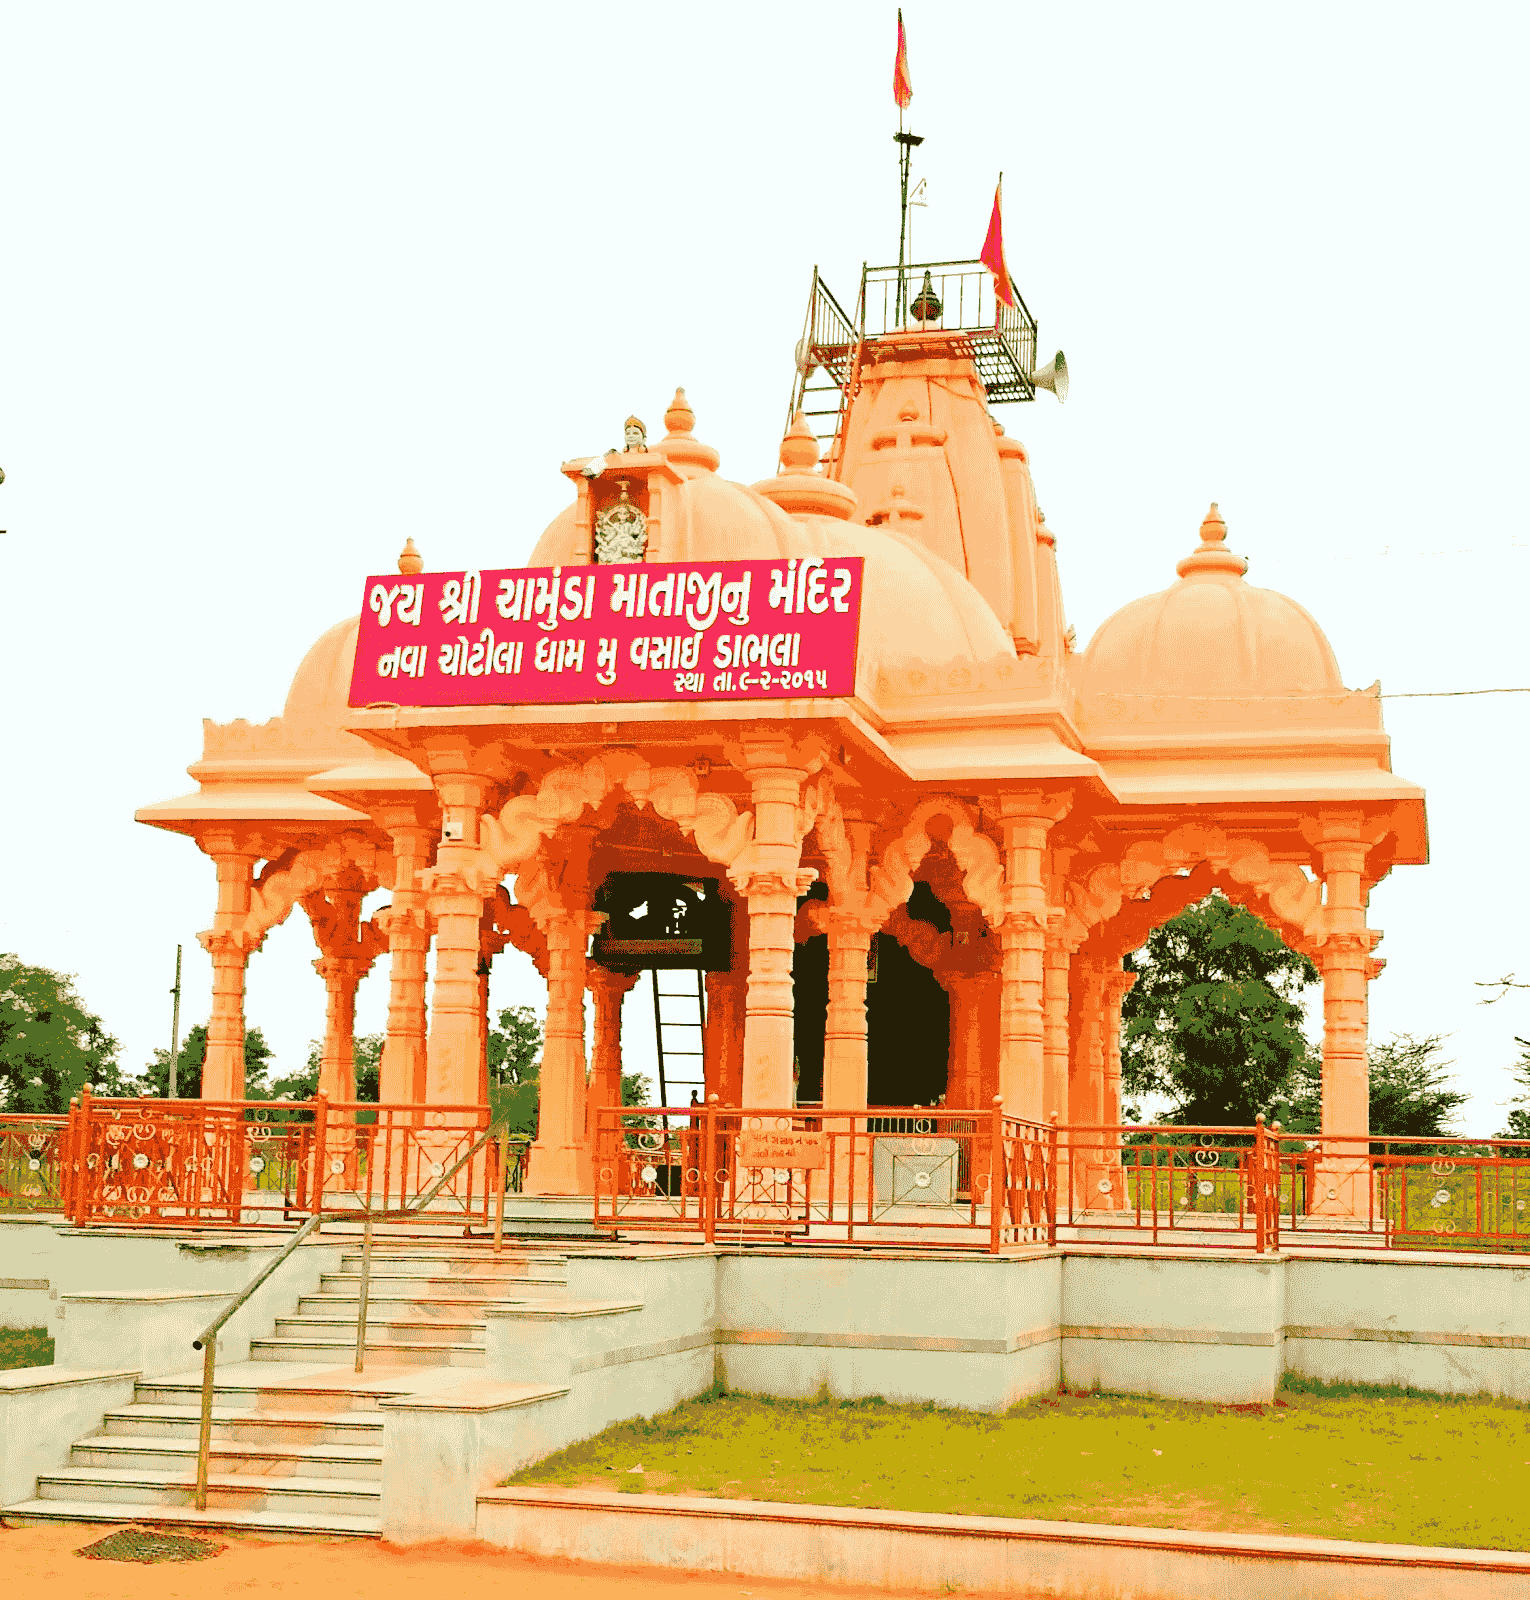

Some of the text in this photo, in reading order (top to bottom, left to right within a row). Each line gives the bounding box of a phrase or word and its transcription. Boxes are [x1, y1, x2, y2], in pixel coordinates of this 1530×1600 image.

[369, 557, 852, 632] જય શ્રી ચામુંડા માતાજીનુ મંદિર
[376, 627, 801, 686] નવા ચોટીલા ધામ મુ વસાઈ ડાભલા
[673, 672, 705, 693] સ્થા
